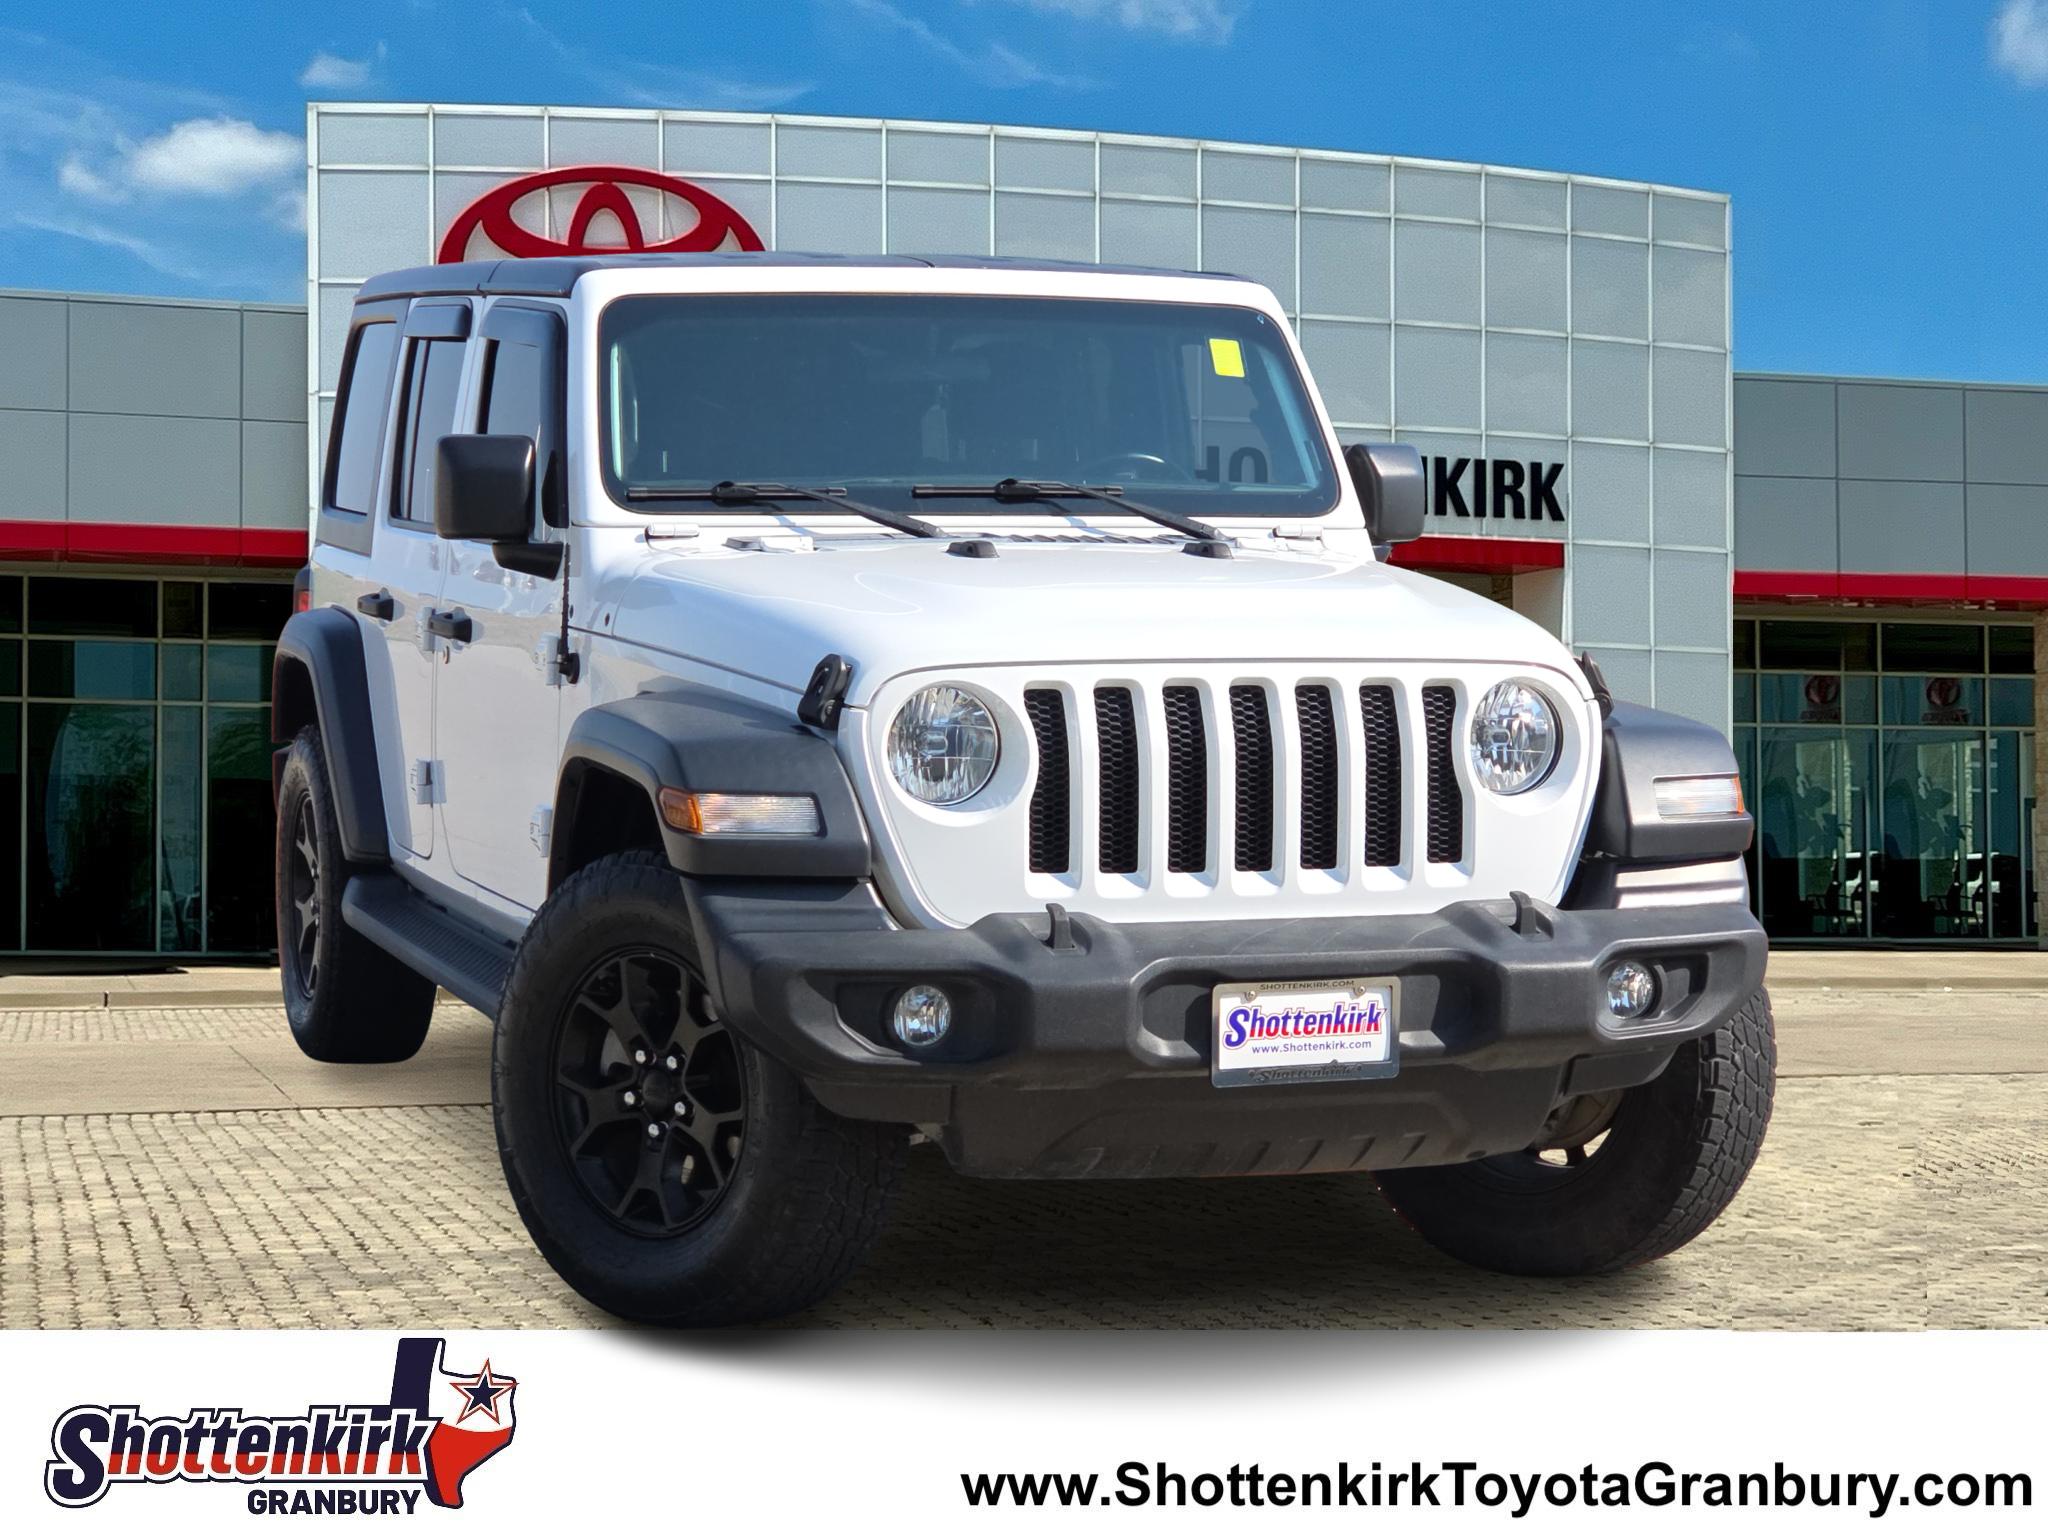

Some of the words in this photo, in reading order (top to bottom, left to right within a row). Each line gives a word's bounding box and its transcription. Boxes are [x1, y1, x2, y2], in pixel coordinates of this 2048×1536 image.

[1422, 456, 1565, 521] KIRK
[1260, 980, 1355, 990] SHOTTENKIRK.COM
[1224, 1001, 1385, 1048] Shottenkirk
[1252, 1040, 1372, 1054] www.Shottenkirk.com
